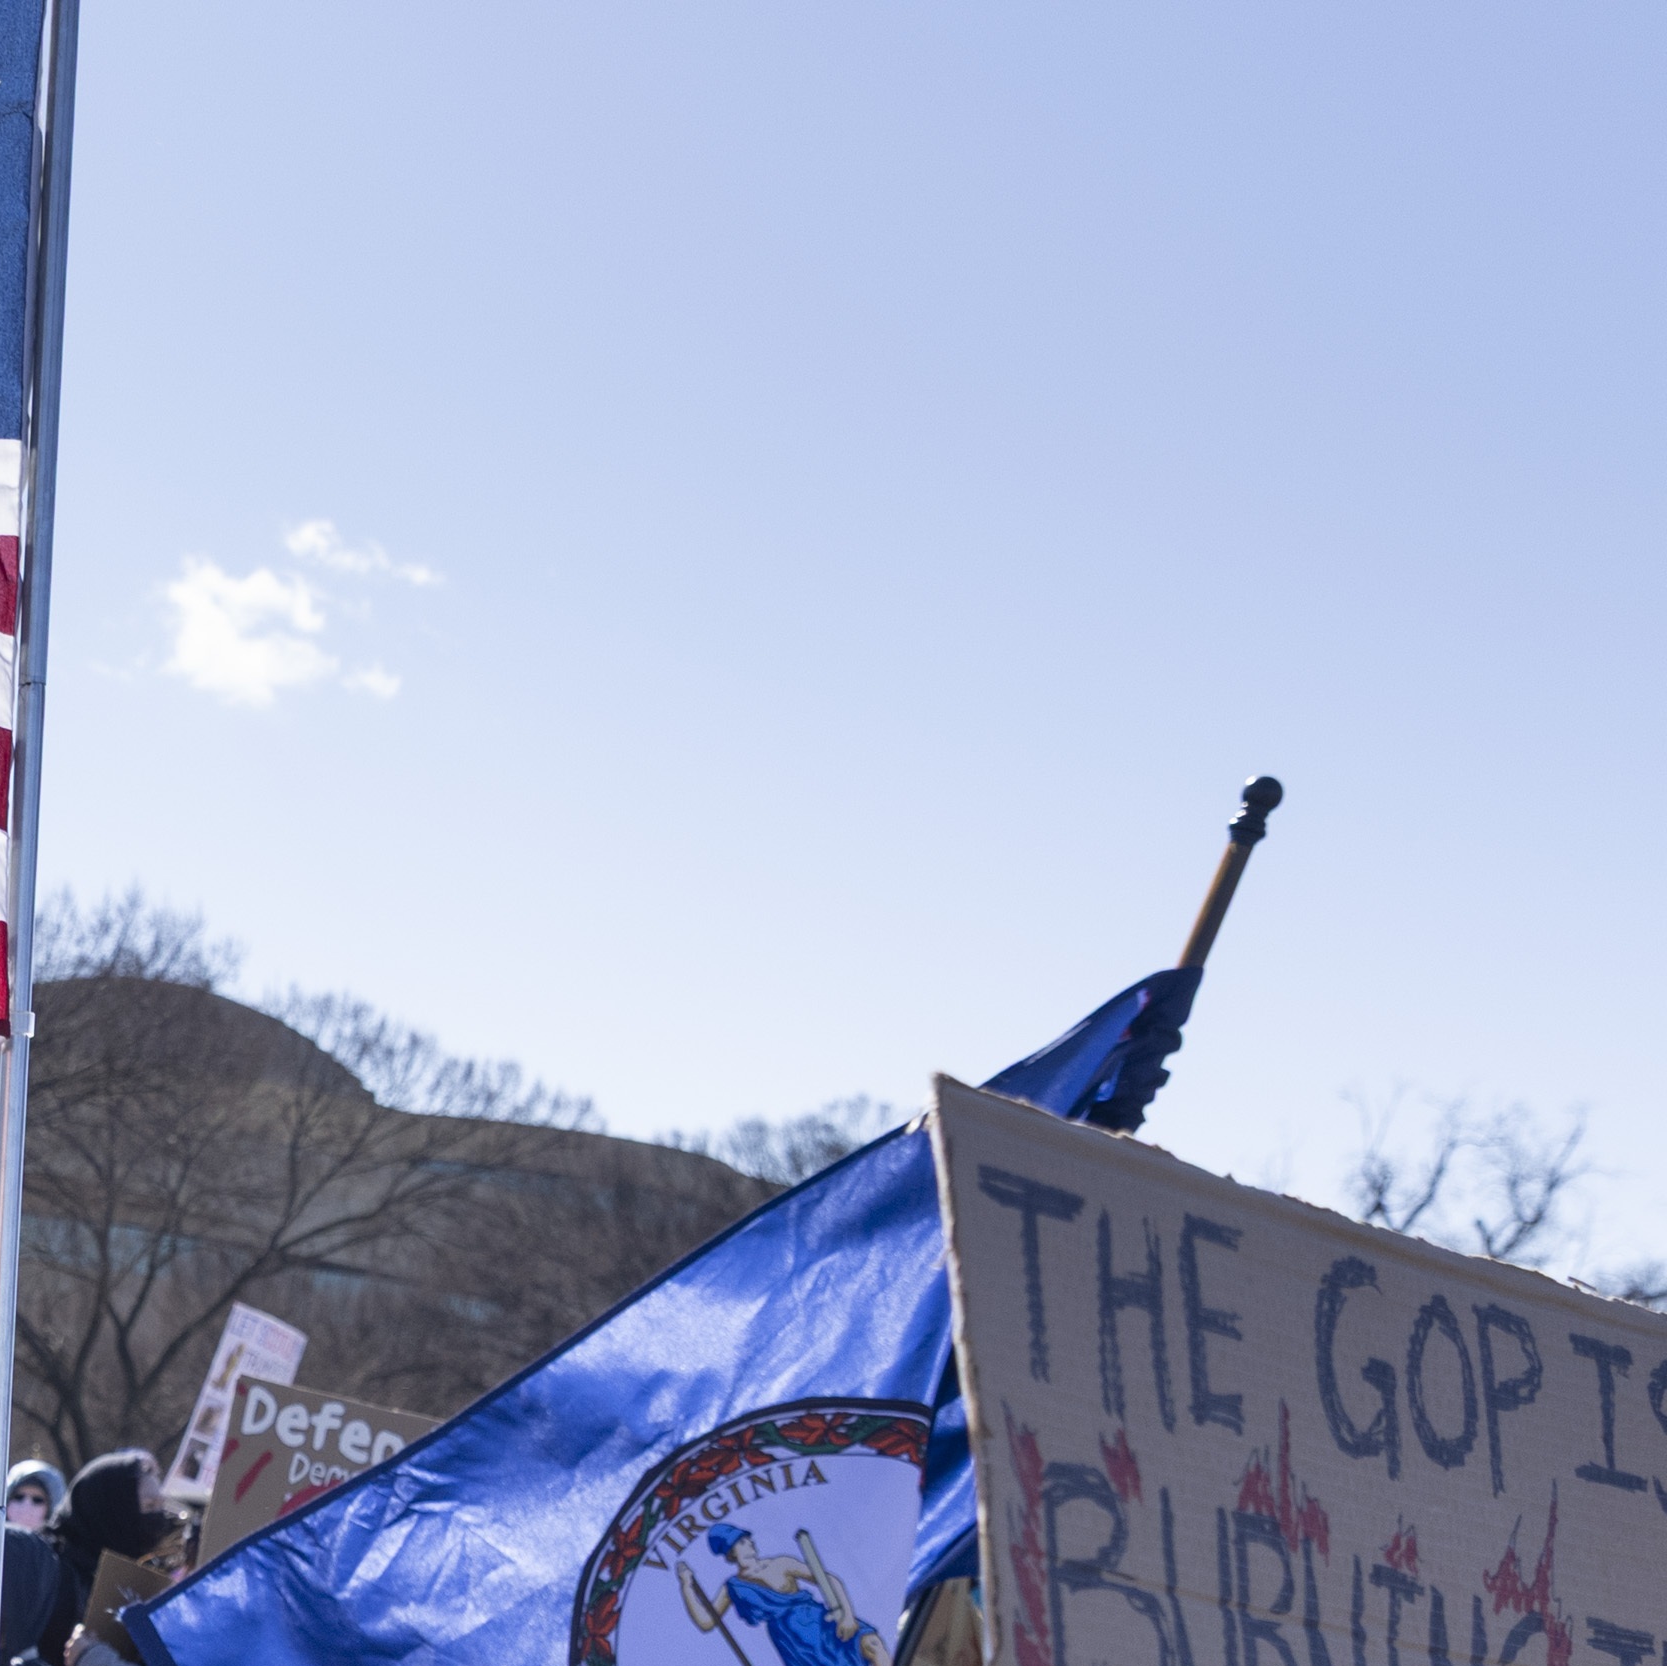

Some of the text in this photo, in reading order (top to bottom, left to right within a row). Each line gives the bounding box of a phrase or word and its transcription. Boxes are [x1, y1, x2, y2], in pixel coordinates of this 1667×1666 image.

[978, 1164, 1245, 1436] THE
[1314, 1254, 1544, 1500] GOP
[288, 1452, 365, 1486] Dem
[643, 1459, 829, 1572] VIRGINIA
